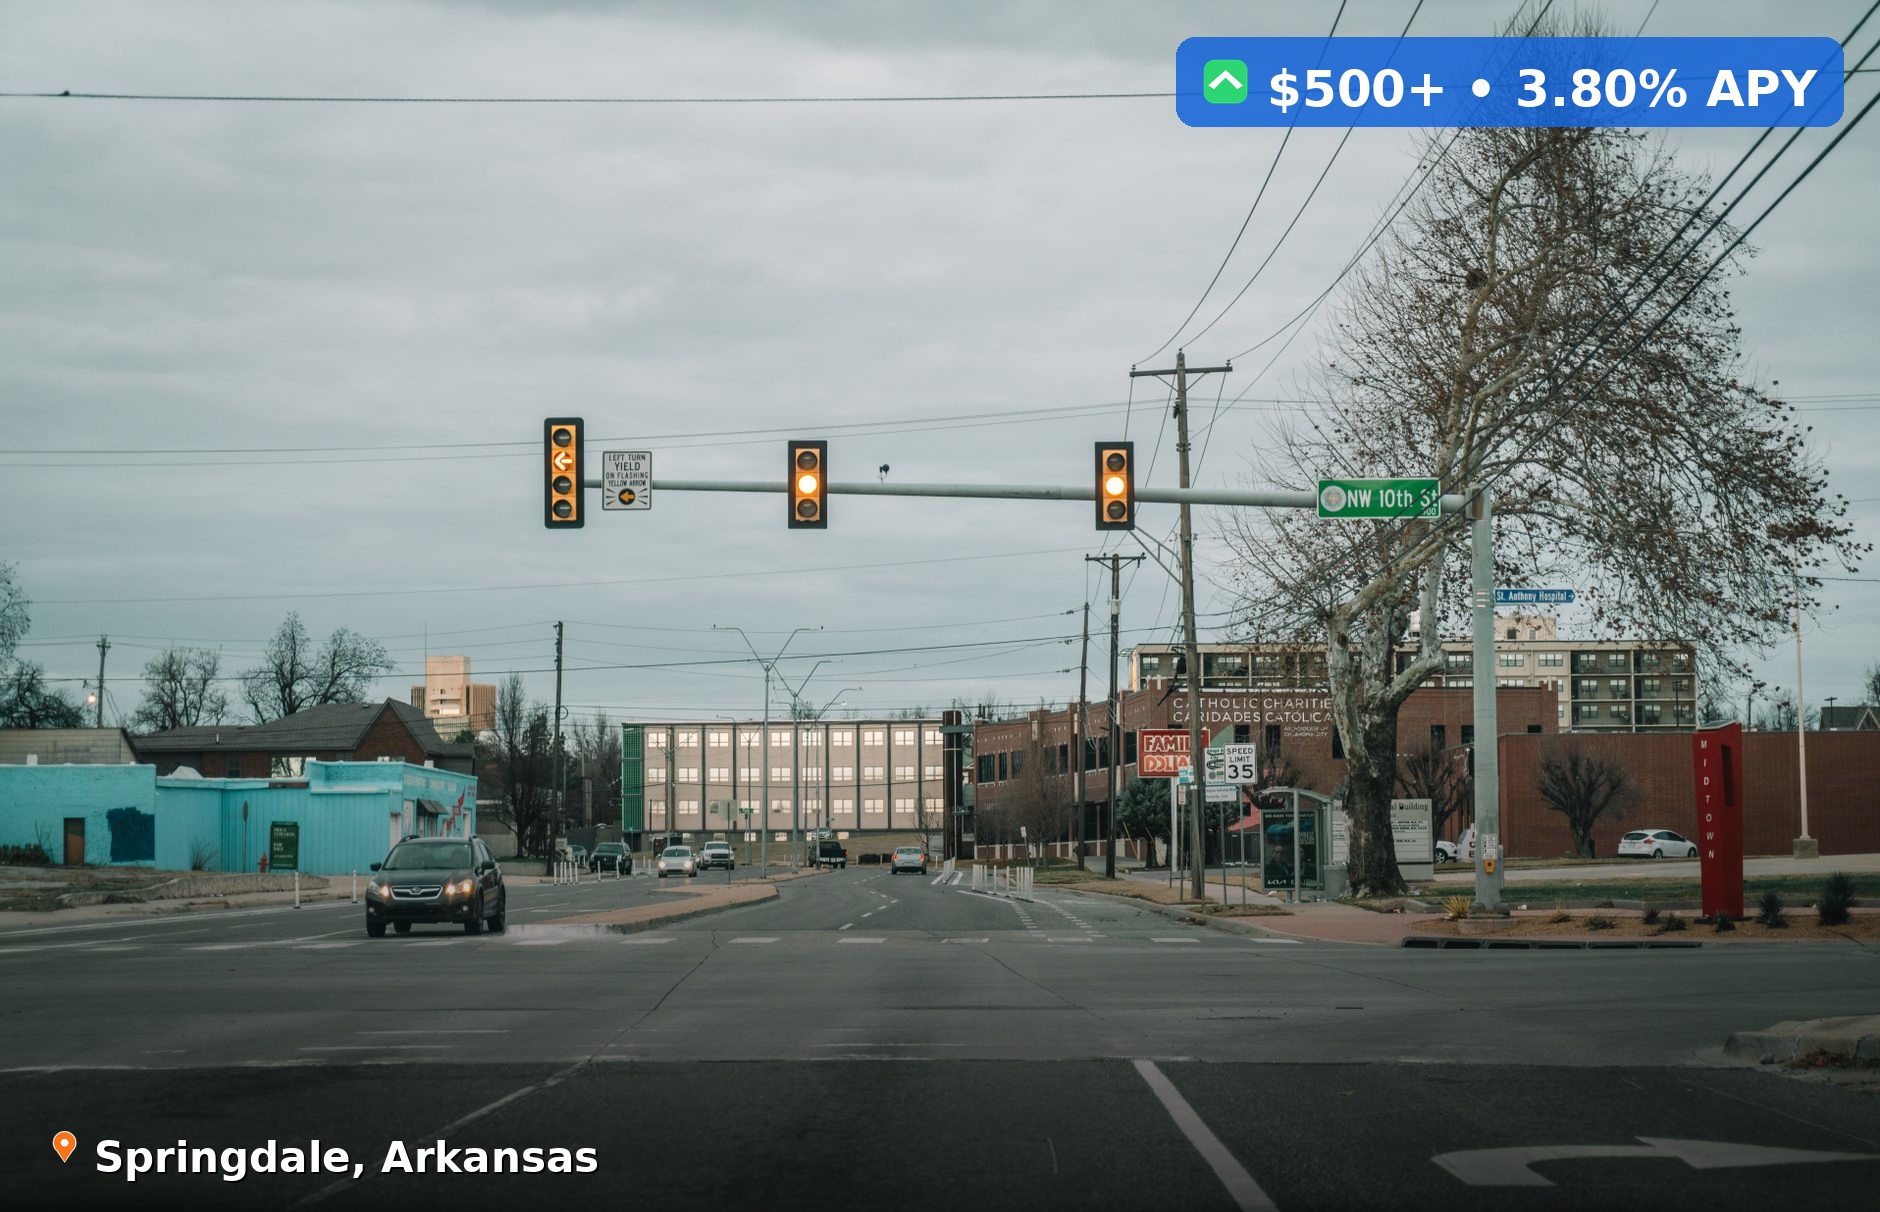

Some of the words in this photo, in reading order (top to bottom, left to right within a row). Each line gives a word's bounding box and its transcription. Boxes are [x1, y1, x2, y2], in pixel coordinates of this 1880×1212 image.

[615, 462, 640, 471] YIELD
[1347, 489, 1371, 508] NW
[1379, 489, 1413, 508] 10th
[1420, 489, 1437, 507] St
[1496, 592, 1506, 601] St.
[1508, 592, 1537, 603] Anthony
[1539, 592, 1567, 603] Hospital
[1173, 697, 1258, 709] CTHOLIC
[1263, 697, 1332, 709] CHARITIE
[1265, 709, 1333, 723] CATÓLICA
[1144, 735, 1203, 752] FAMIL
[1226, 747, 1254, 755] SPEED
[1144, 755, 1191, 772] DOLLA
[1228, 764, 1254, 779] 35
[1700, 739, 1715, 860] MIDTOWN
